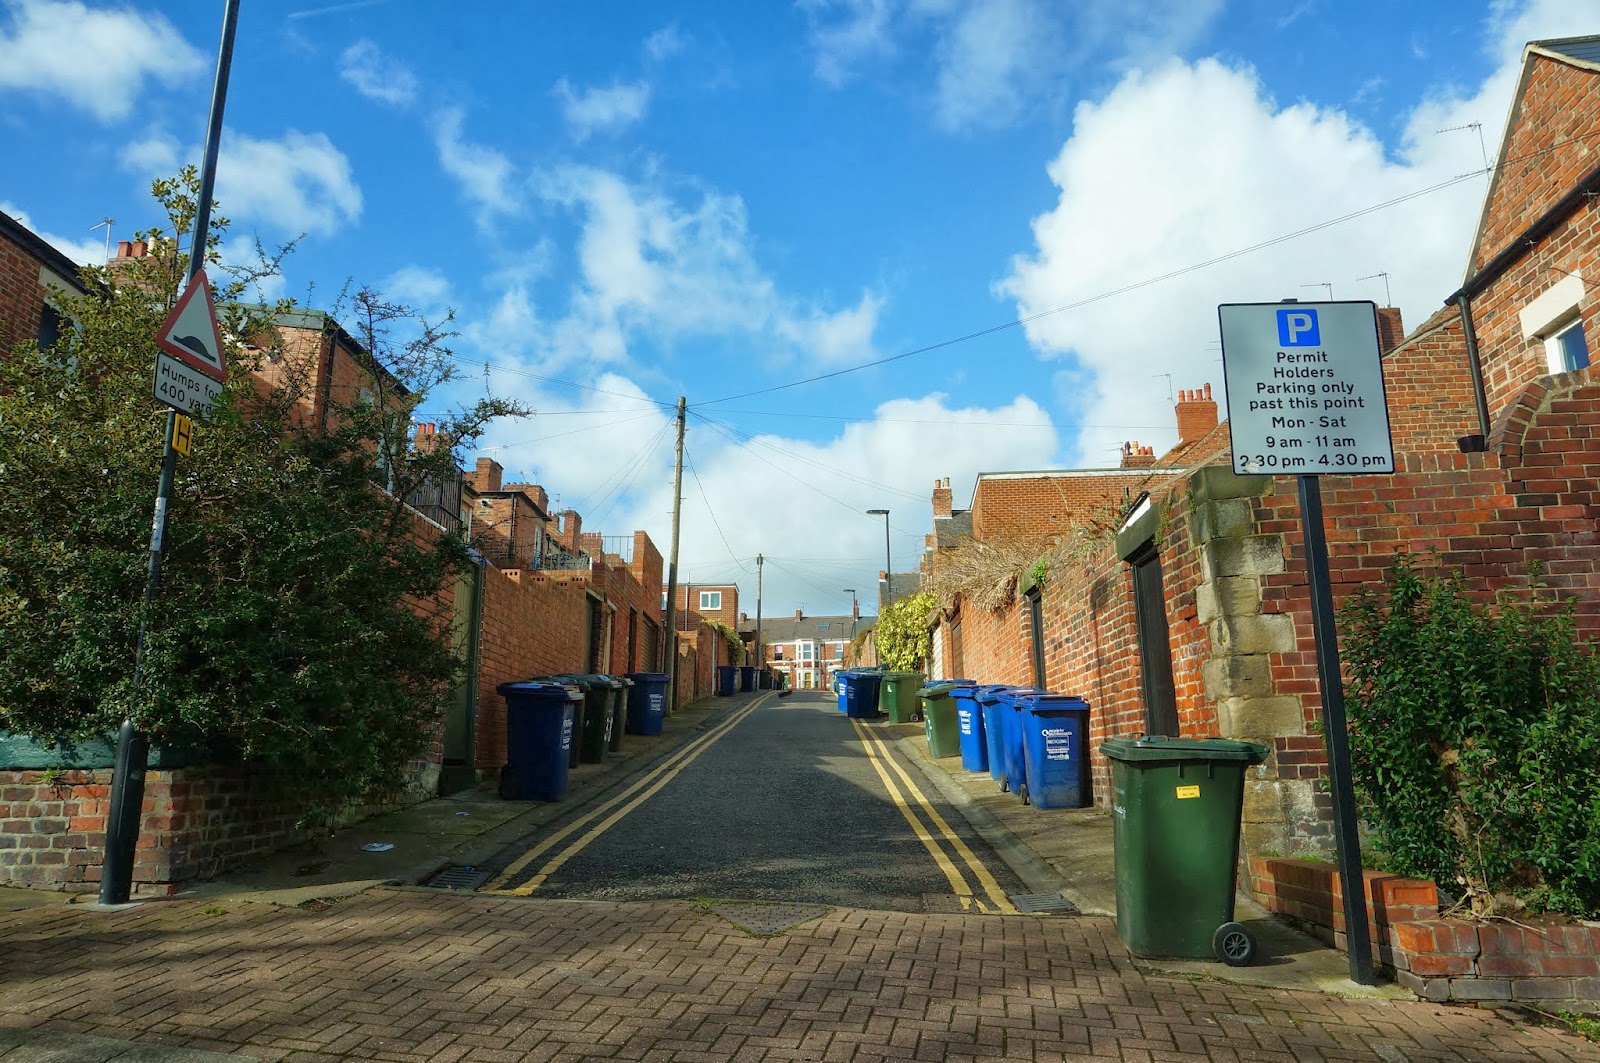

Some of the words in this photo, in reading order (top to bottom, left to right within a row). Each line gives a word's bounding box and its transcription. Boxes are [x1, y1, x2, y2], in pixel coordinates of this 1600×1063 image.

[1287, 313, 1313, 343] P
[1277, 351, 1328, 363] Permit
[1274, 366, 1334, 378] Holders
[161, 362, 200, 392] Humps
[205, 384, 219, 400] for
[1256, 382, 1316, 395] Parking
[1321, 381, 1354, 395] only
[160, 382, 185, 402] 400
[1249, 398, 1283, 411] past
[1289, 397, 1318, 409] this
[1324, 396, 1364, 410] point
[1272, 416, 1305, 428] Mon
[1319, 415, 1346, 428] Sat
[176, 418, 190, 451] H
[1239, 454, 1277, 467] 230
[1282, 457, 1305, 469] pm
[1318, 453, 1357, 467] 4.30
[1362, 455, 1386, 468] pm
